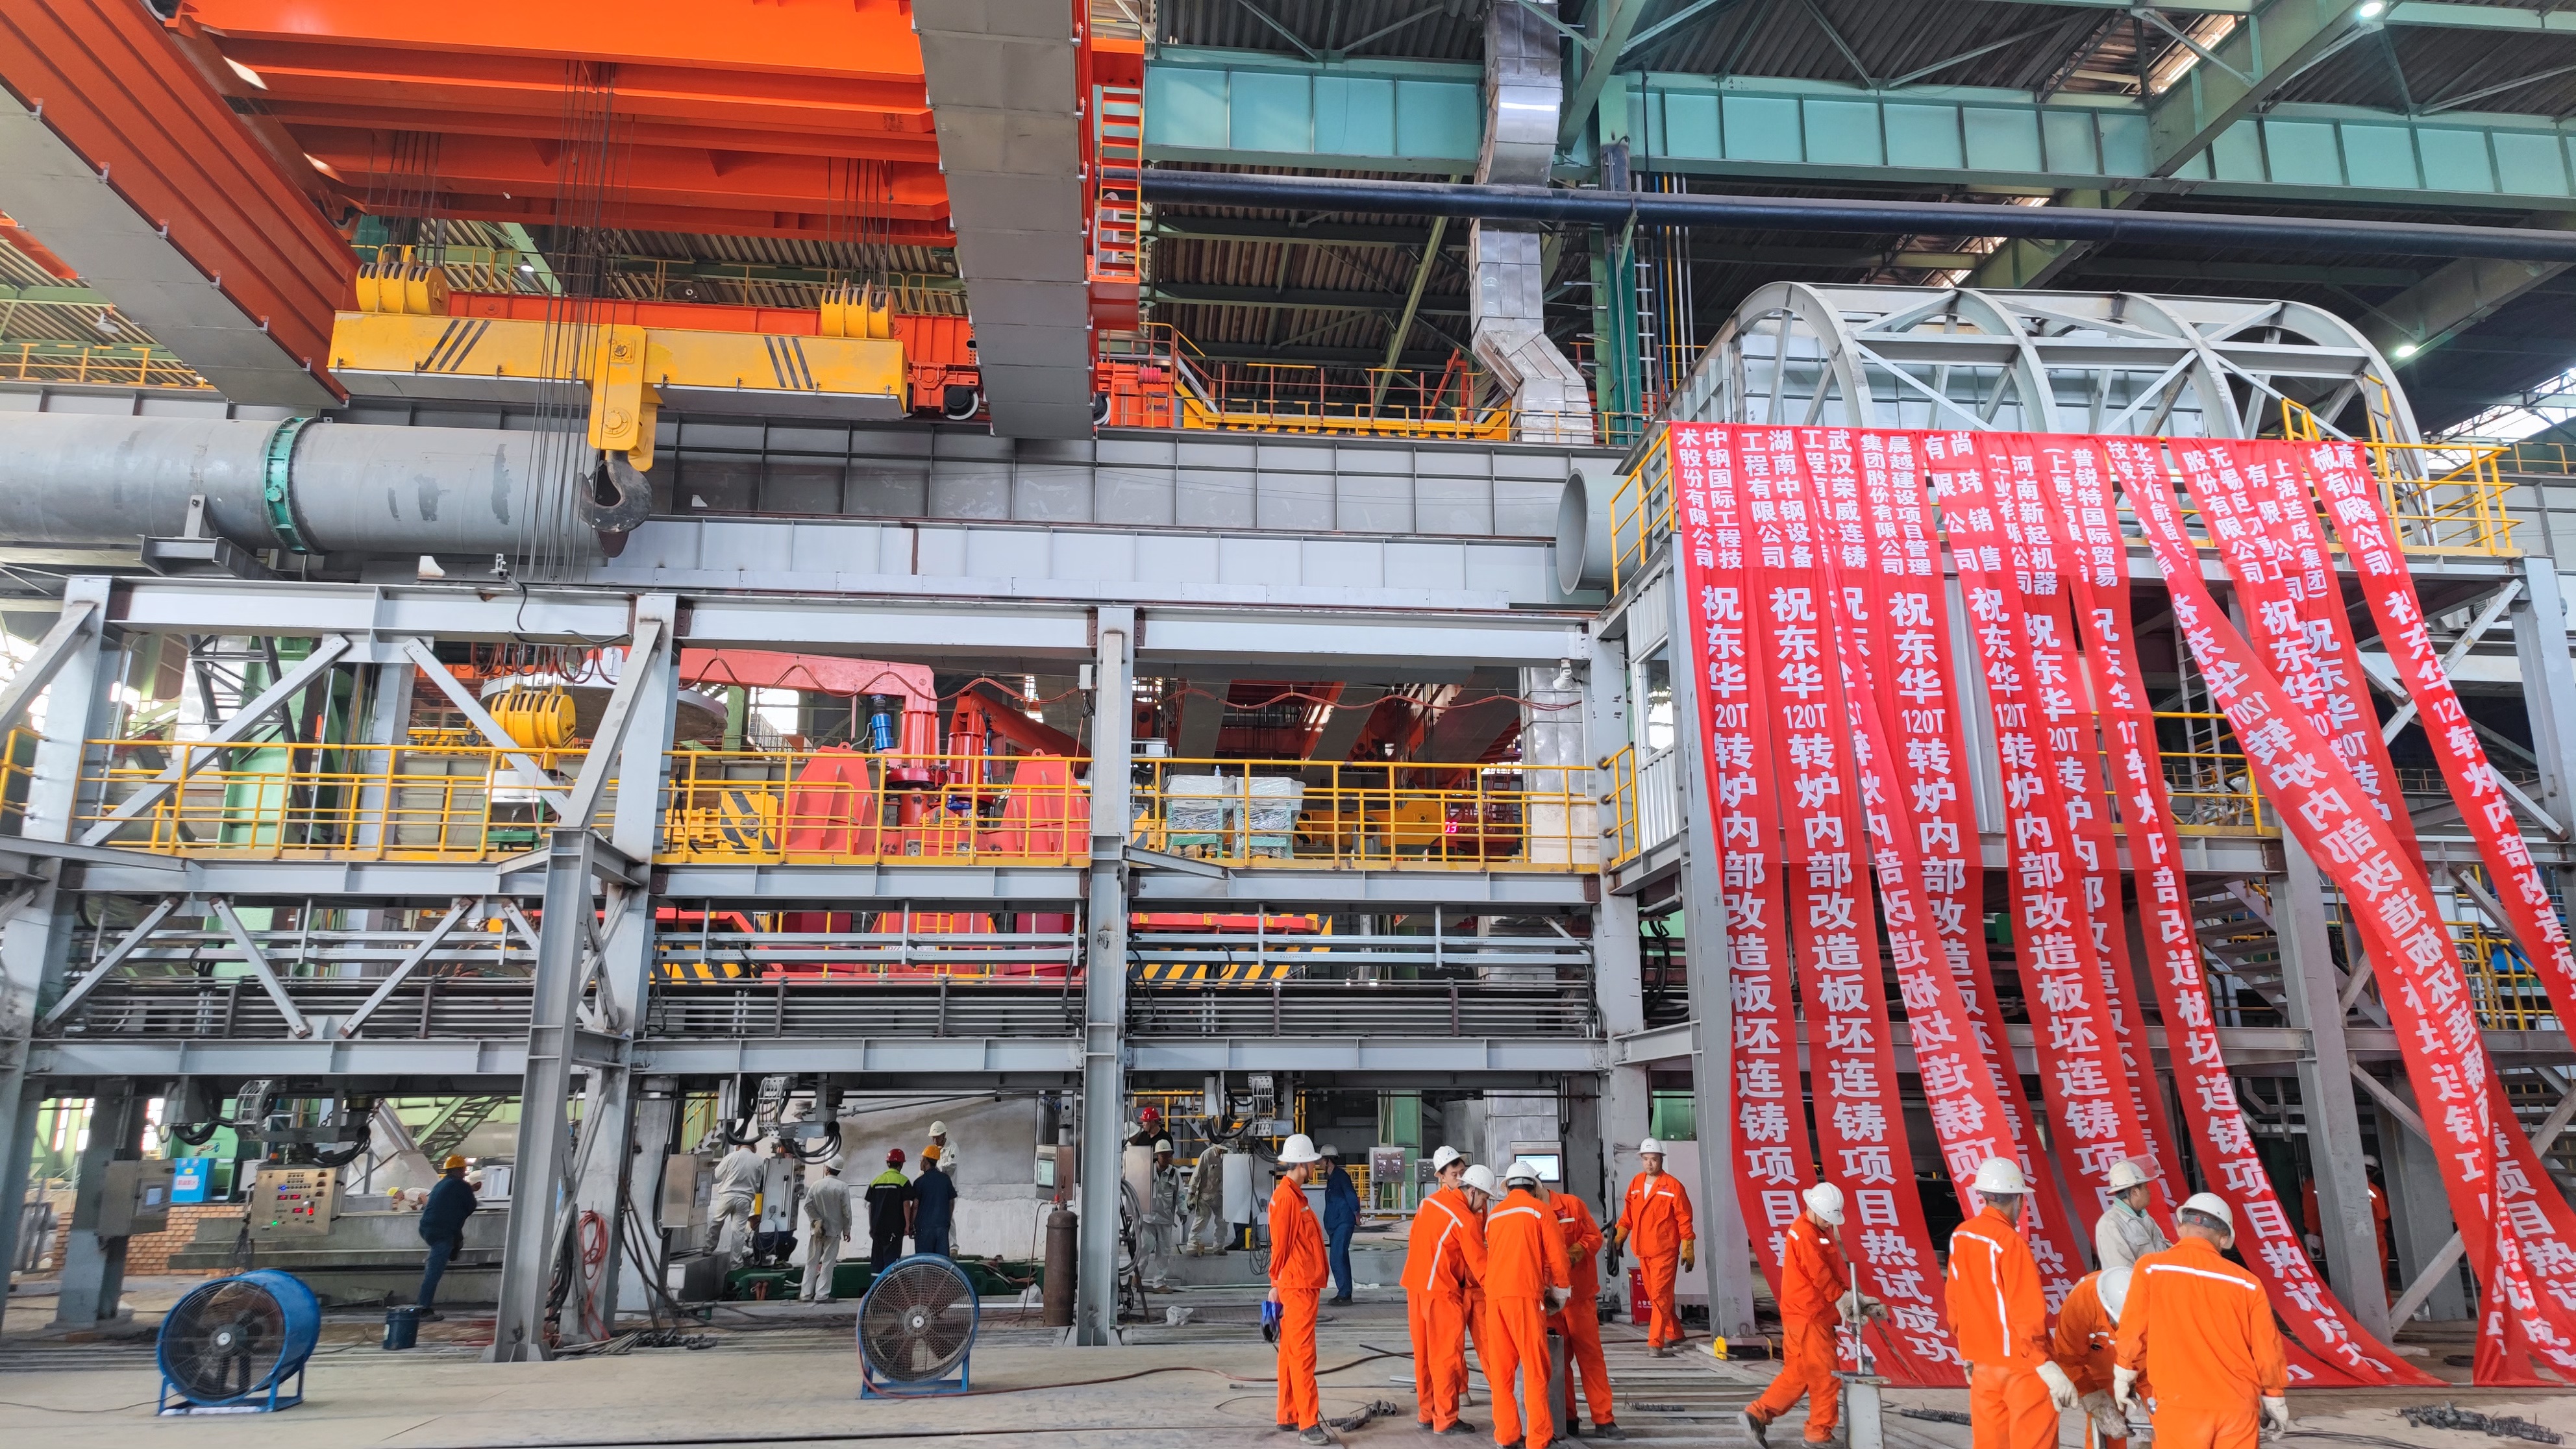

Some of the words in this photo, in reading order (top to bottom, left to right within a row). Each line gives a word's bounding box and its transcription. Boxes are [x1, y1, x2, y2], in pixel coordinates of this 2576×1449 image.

[1677, 428, 1715, 569] 术股份有限公司
[1704, 427, 1744, 569] 中钢国际工程技
[1741, 432, 1786, 569] 工程有限公司
[1768, 428, 1814, 569] 湖南中钢设备
[1828, 429, 1868, 569] 武汉荣威连铸
[1861, 434, 1904, 576] 集团股份有限公司
[1889, 435, 1933, 576] 晨越建设项目管理
[1924, 434, 1979, 573] 有限公司
[1951, 432, 2001, 573] 尚玮销售
[2012, 454, 2058, 595] 河南新起机器
[2072, 448, 2119, 588] 普锐特国际贸易
[2182, 450, 2266, 584] 股份有限公司
[2245, 463, 2305, 602] 有限公司
